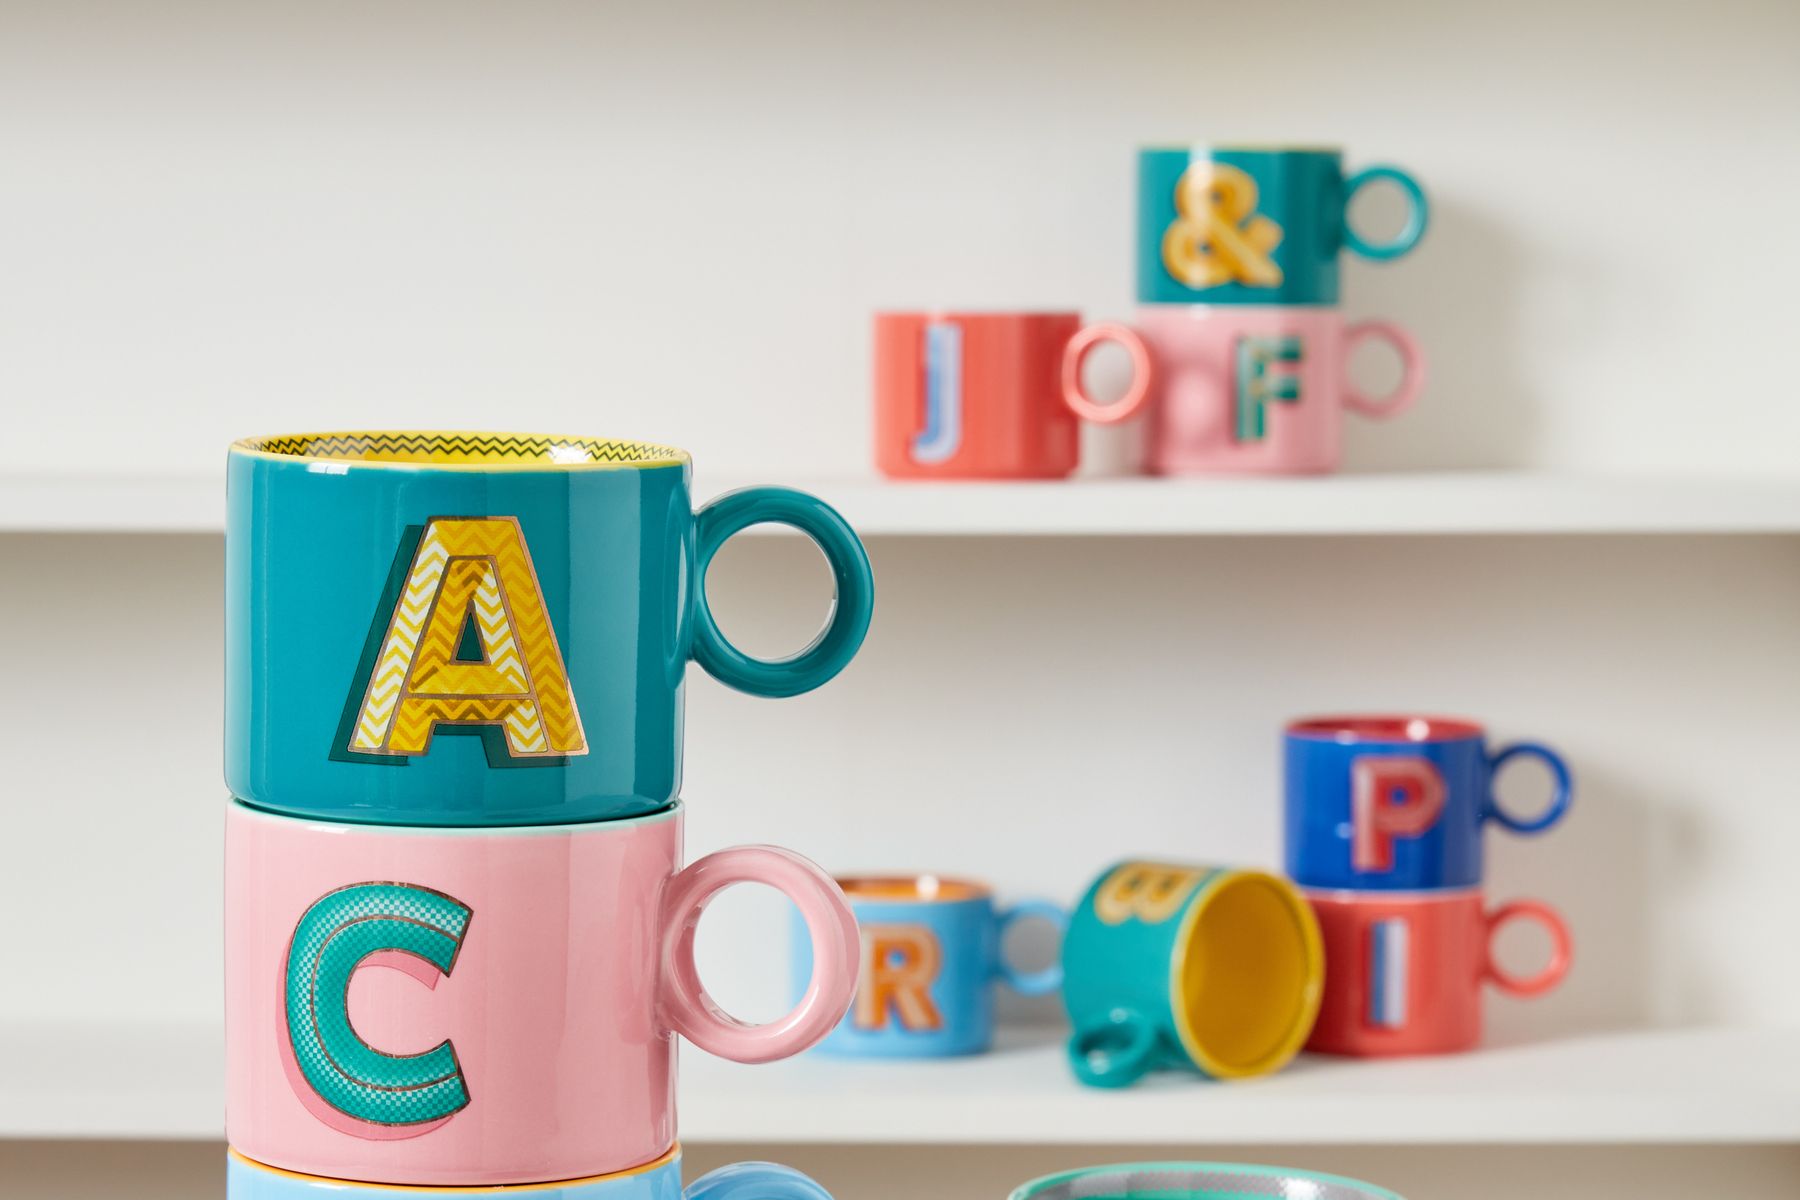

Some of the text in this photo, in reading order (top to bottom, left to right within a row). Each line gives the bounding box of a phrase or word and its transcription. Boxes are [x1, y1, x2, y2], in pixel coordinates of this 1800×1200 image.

[1161, 163, 1284, 289] &
[911, 321, 964, 464] J
[1233, 336, 1304, 442] F
[340, 515, 590, 758] A
[1352, 757, 1447, 872] P
[283, 880, 475, 1128] C
[852, 923, 943, 1032] R
